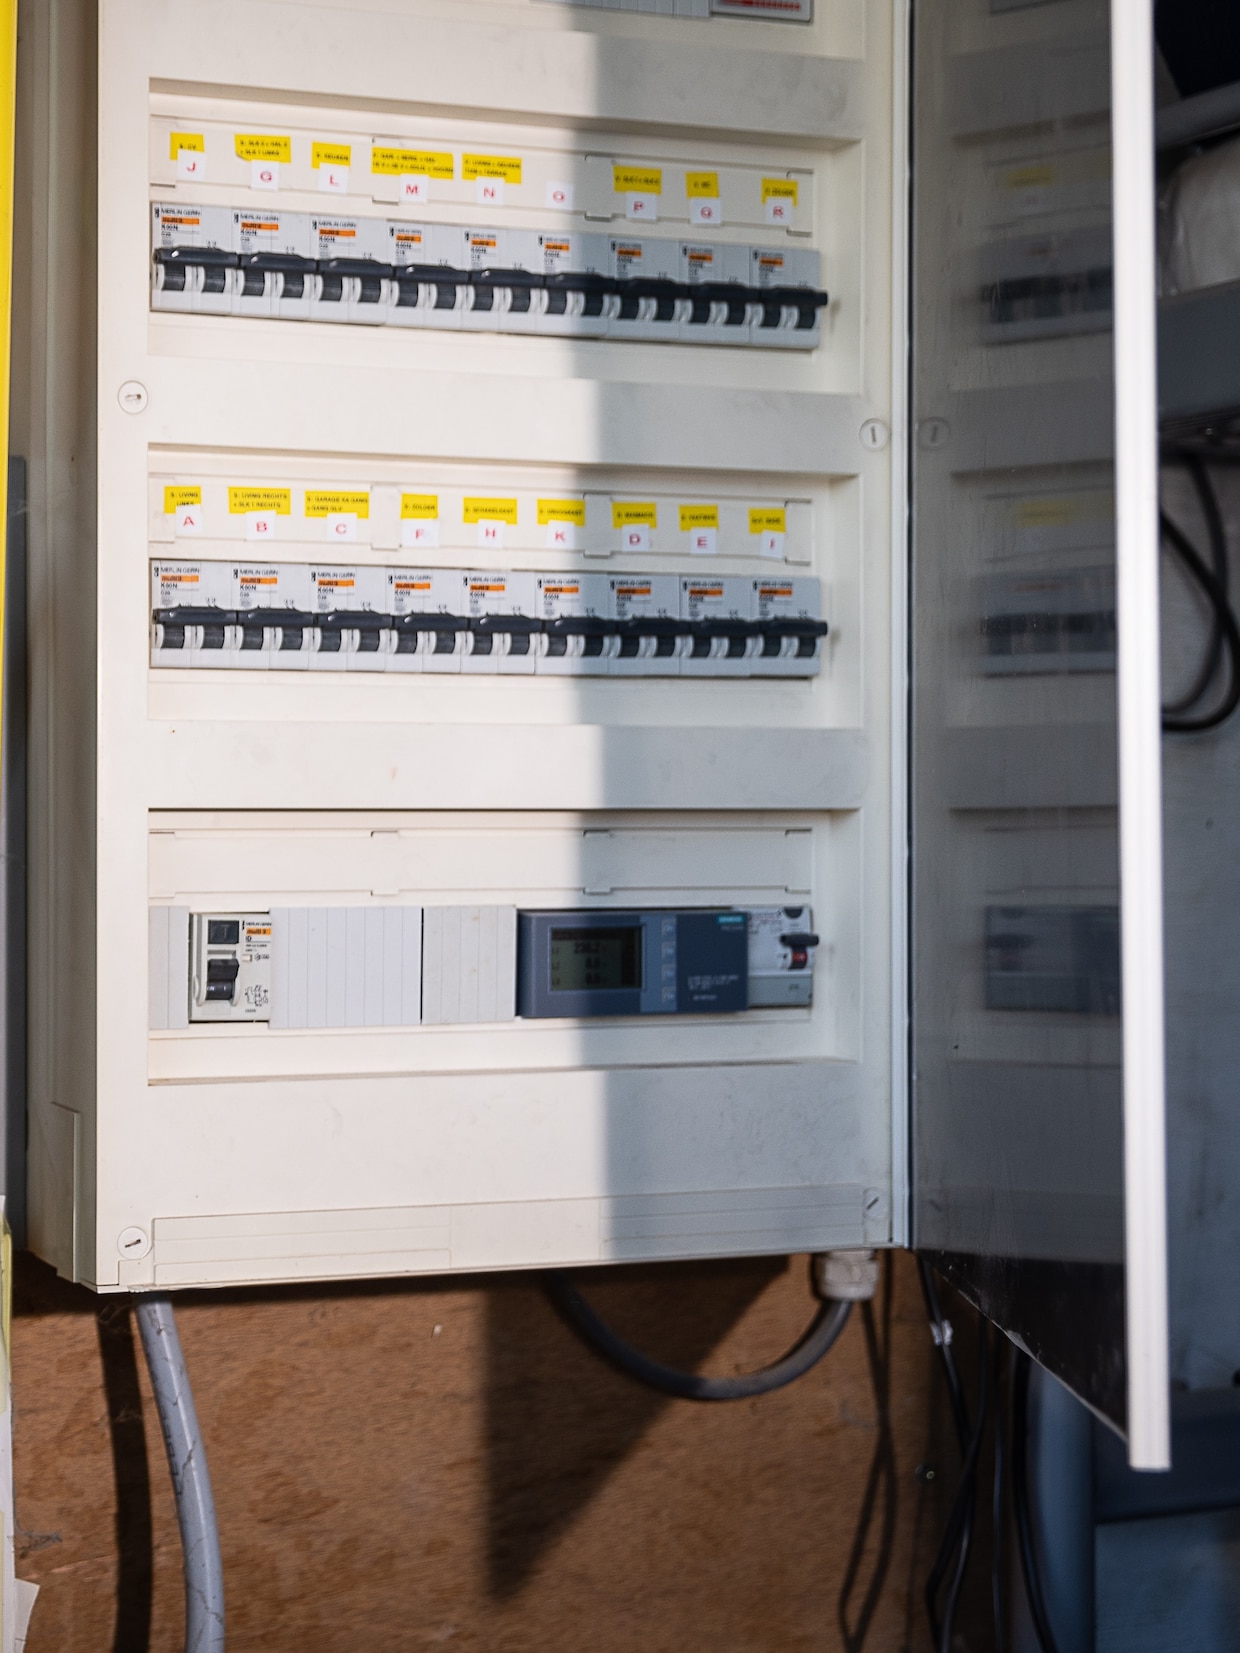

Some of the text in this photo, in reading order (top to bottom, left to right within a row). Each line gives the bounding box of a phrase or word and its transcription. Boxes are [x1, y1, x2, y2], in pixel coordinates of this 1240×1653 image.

[186, 162, 196, 172] J
[329, 175, 339, 186] L
[406, 184, 419, 195] M
[483, 187, 496, 199] N
[633, 201, 644, 212] P
[183, 516, 195, 526] A
[256, 521, 267, 532] B
[335, 523, 347, 534] C
[485, 528, 496, 538] H
[629, 533, 641, 545] D
[697, 536, 707, 548] E
